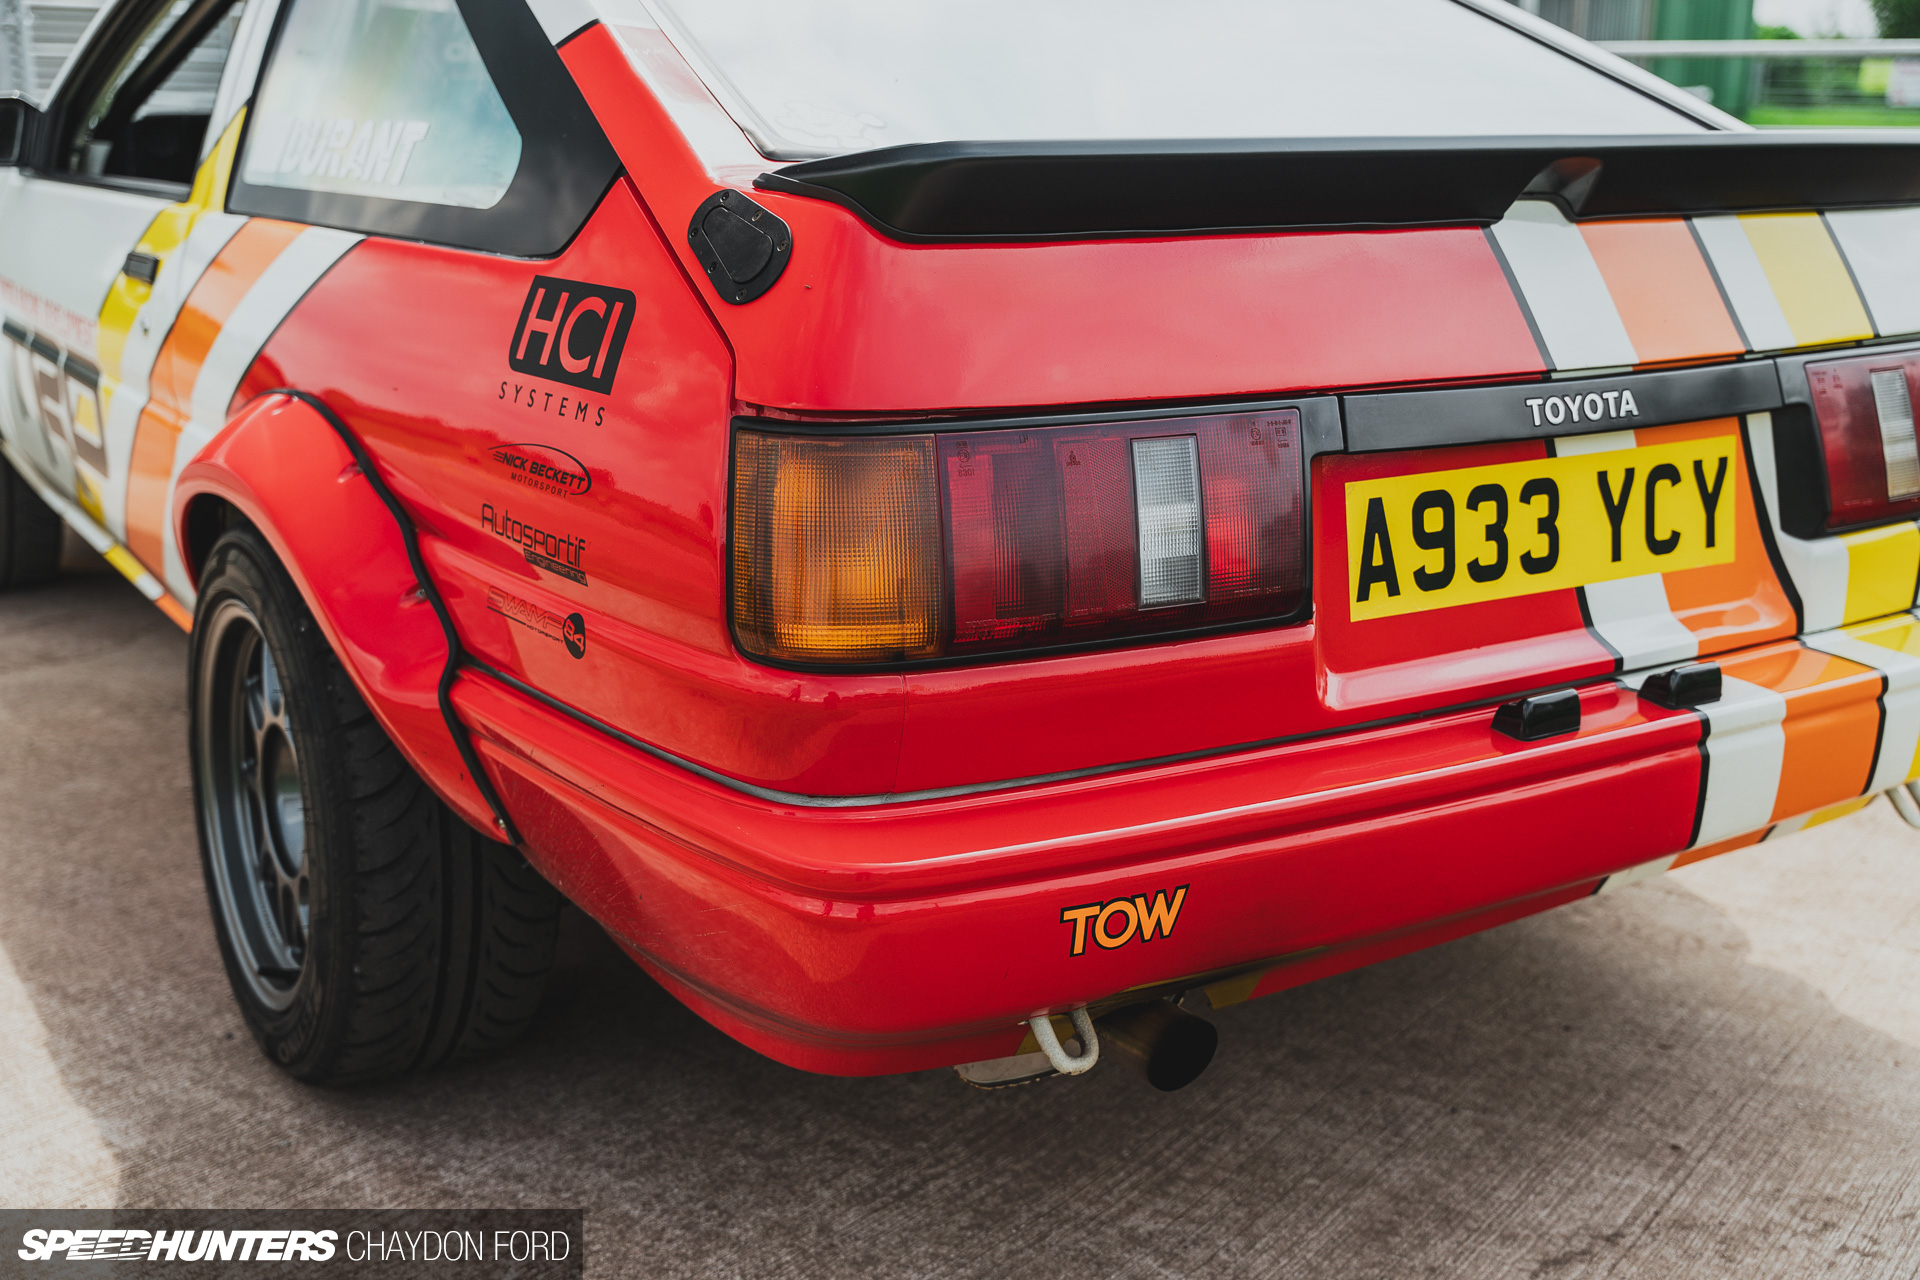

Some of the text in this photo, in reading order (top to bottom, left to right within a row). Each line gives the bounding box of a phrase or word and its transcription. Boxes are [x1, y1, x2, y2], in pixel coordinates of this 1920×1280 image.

[278, 117, 431, 186] DURANT
[515, 287, 625, 379] HCI
[498, 381, 606, 427] SYSTEMS
[1525, 389, 1640, 427] TOYOTA
[501, 451, 586, 490] NICK BECKETT
[510, 471, 569, 499] MOTORSPORT
[481, 503, 586, 568] Autosportif
[1355, 456, 1729, 603] A933 YCY
[525, 550, 587, 585] Engineering
[487, 585, 585, 652] SWAMP 84
[526, 623, 564, 644] MOTORSPORT
[1059, 883, 1191, 958] TOW
